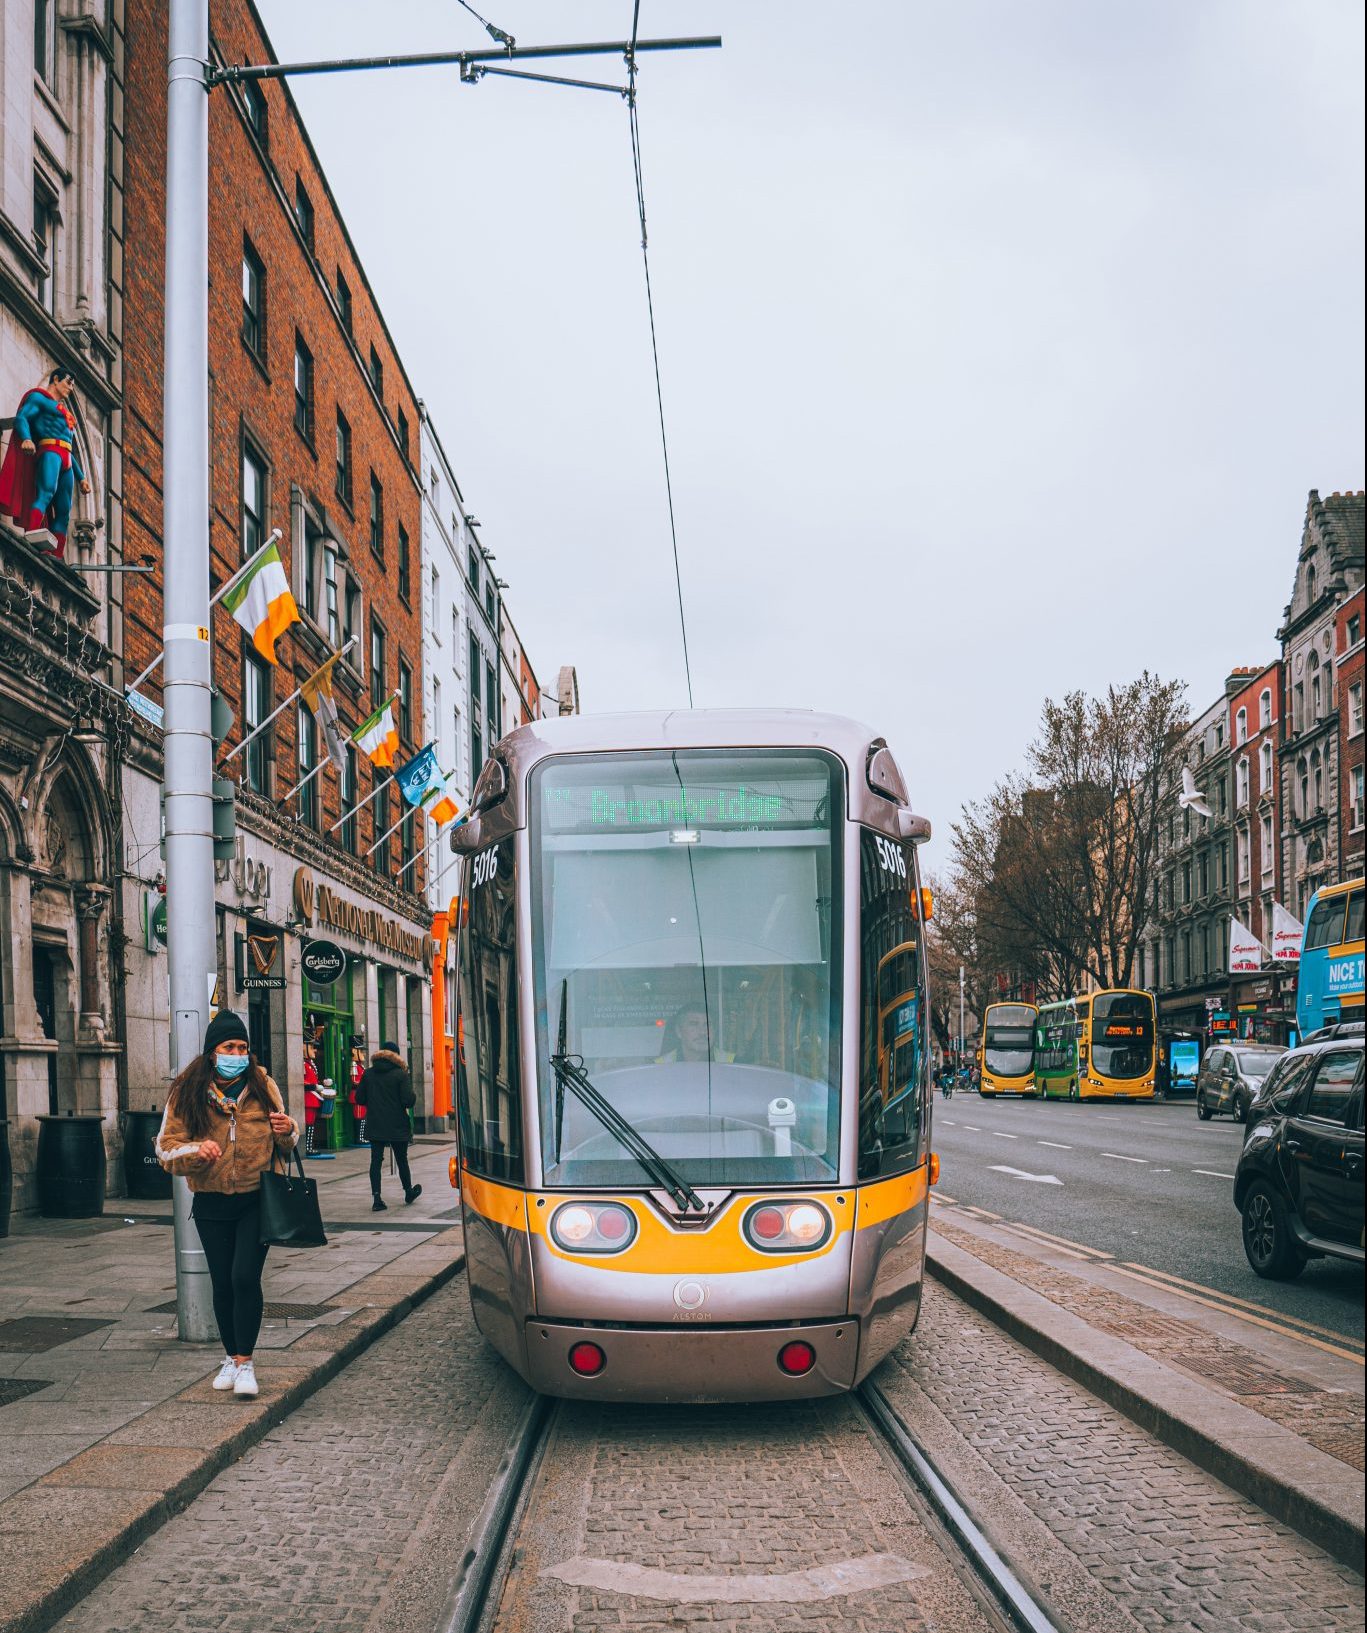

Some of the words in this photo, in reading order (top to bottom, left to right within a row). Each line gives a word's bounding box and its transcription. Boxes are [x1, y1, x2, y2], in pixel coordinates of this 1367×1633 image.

[874, 835, 907, 879] 5016
[472, 844, 499, 889] 5016
[318, 884, 374, 943] NATIONAL
[156, 924, 167, 933] He
[305, 955, 340, 969] Carlsberg
[1329, 961, 1355, 983] NICE
[1357, 959, 1366, 979] T
[243, 978, 282, 988] GUINNESS
[143, 1156, 157, 1164] GUI
[672, 1312, 712, 1321] ALSTOM
